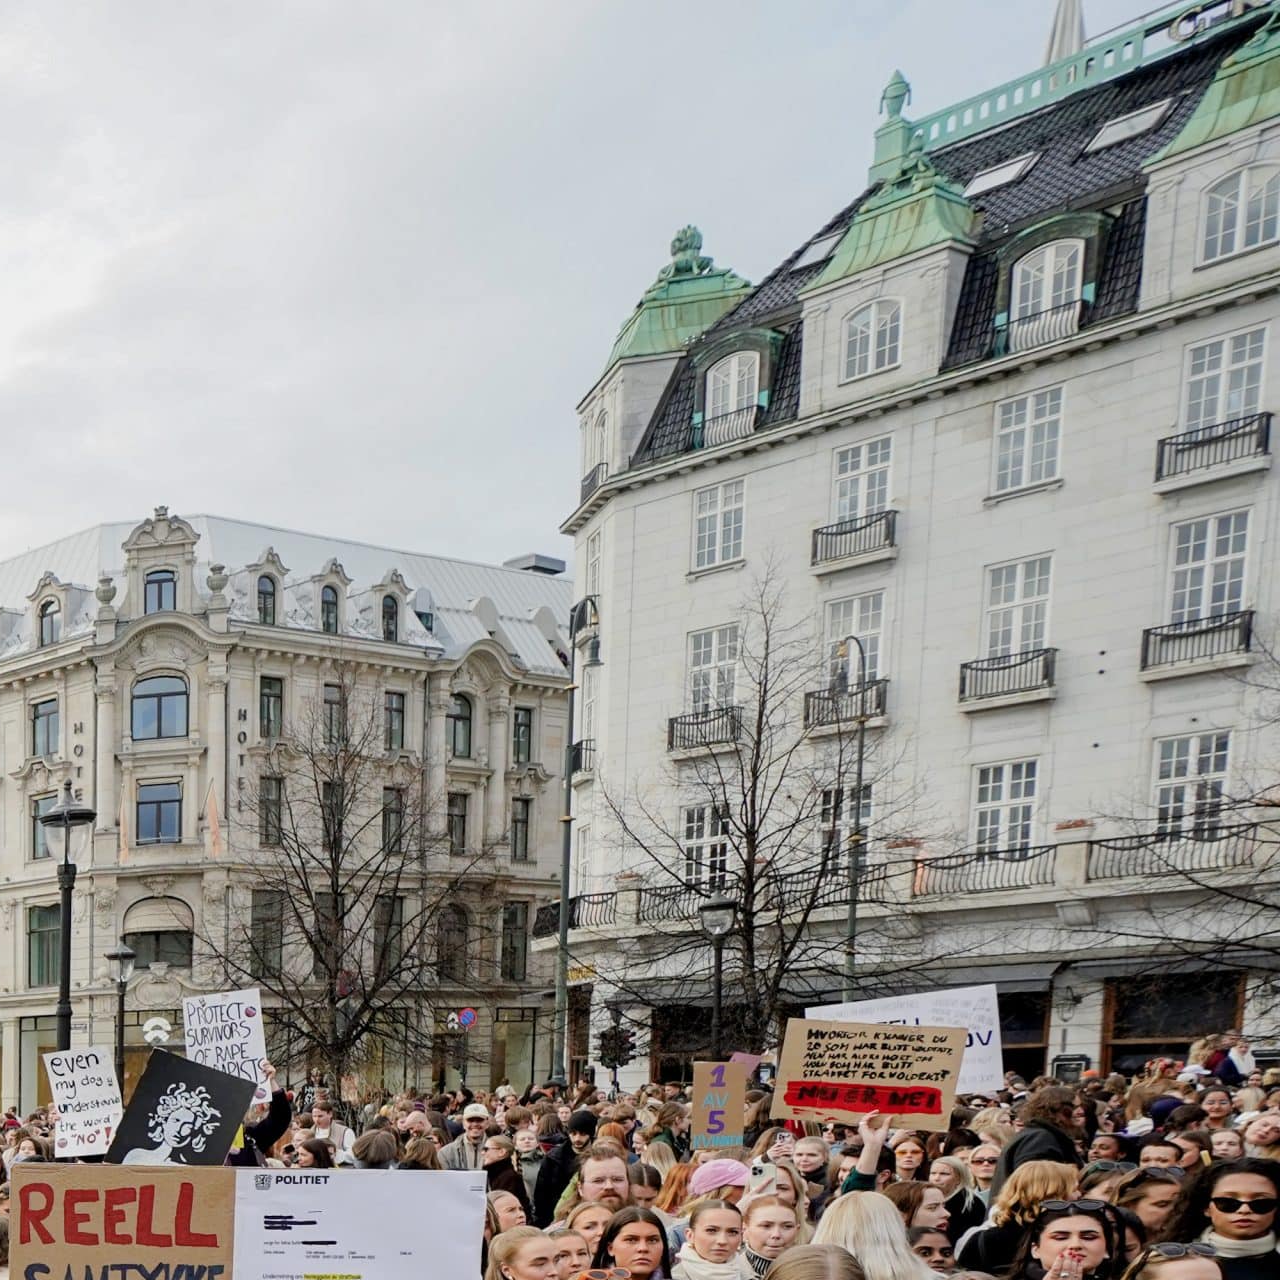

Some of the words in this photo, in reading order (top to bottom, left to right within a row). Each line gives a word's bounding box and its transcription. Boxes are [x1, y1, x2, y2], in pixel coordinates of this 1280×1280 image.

[187, 1003, 243, 1024] PROTECT
[187, 1021, 251, 1047] SURVIVORS
[932, 1035, 947, 1043] DU
[216, 1043, 249, 1060] RAPE
[50, 1053, 99, 1077] even
[710, 1065, 727, 1087] 1
[56, 1079, 76, 1099] my
[81, 1076, 103, 1087] dog
[703, 1094, 728, 1107] AV
[59, 1120, 78, 1132] the
[84, 1114, 110, 1128] word
[707, 1111, 725, 1134] 5
[275, 1175, 330, 1186] POLITIET
[19, 1182, 220, 1248] REELL
